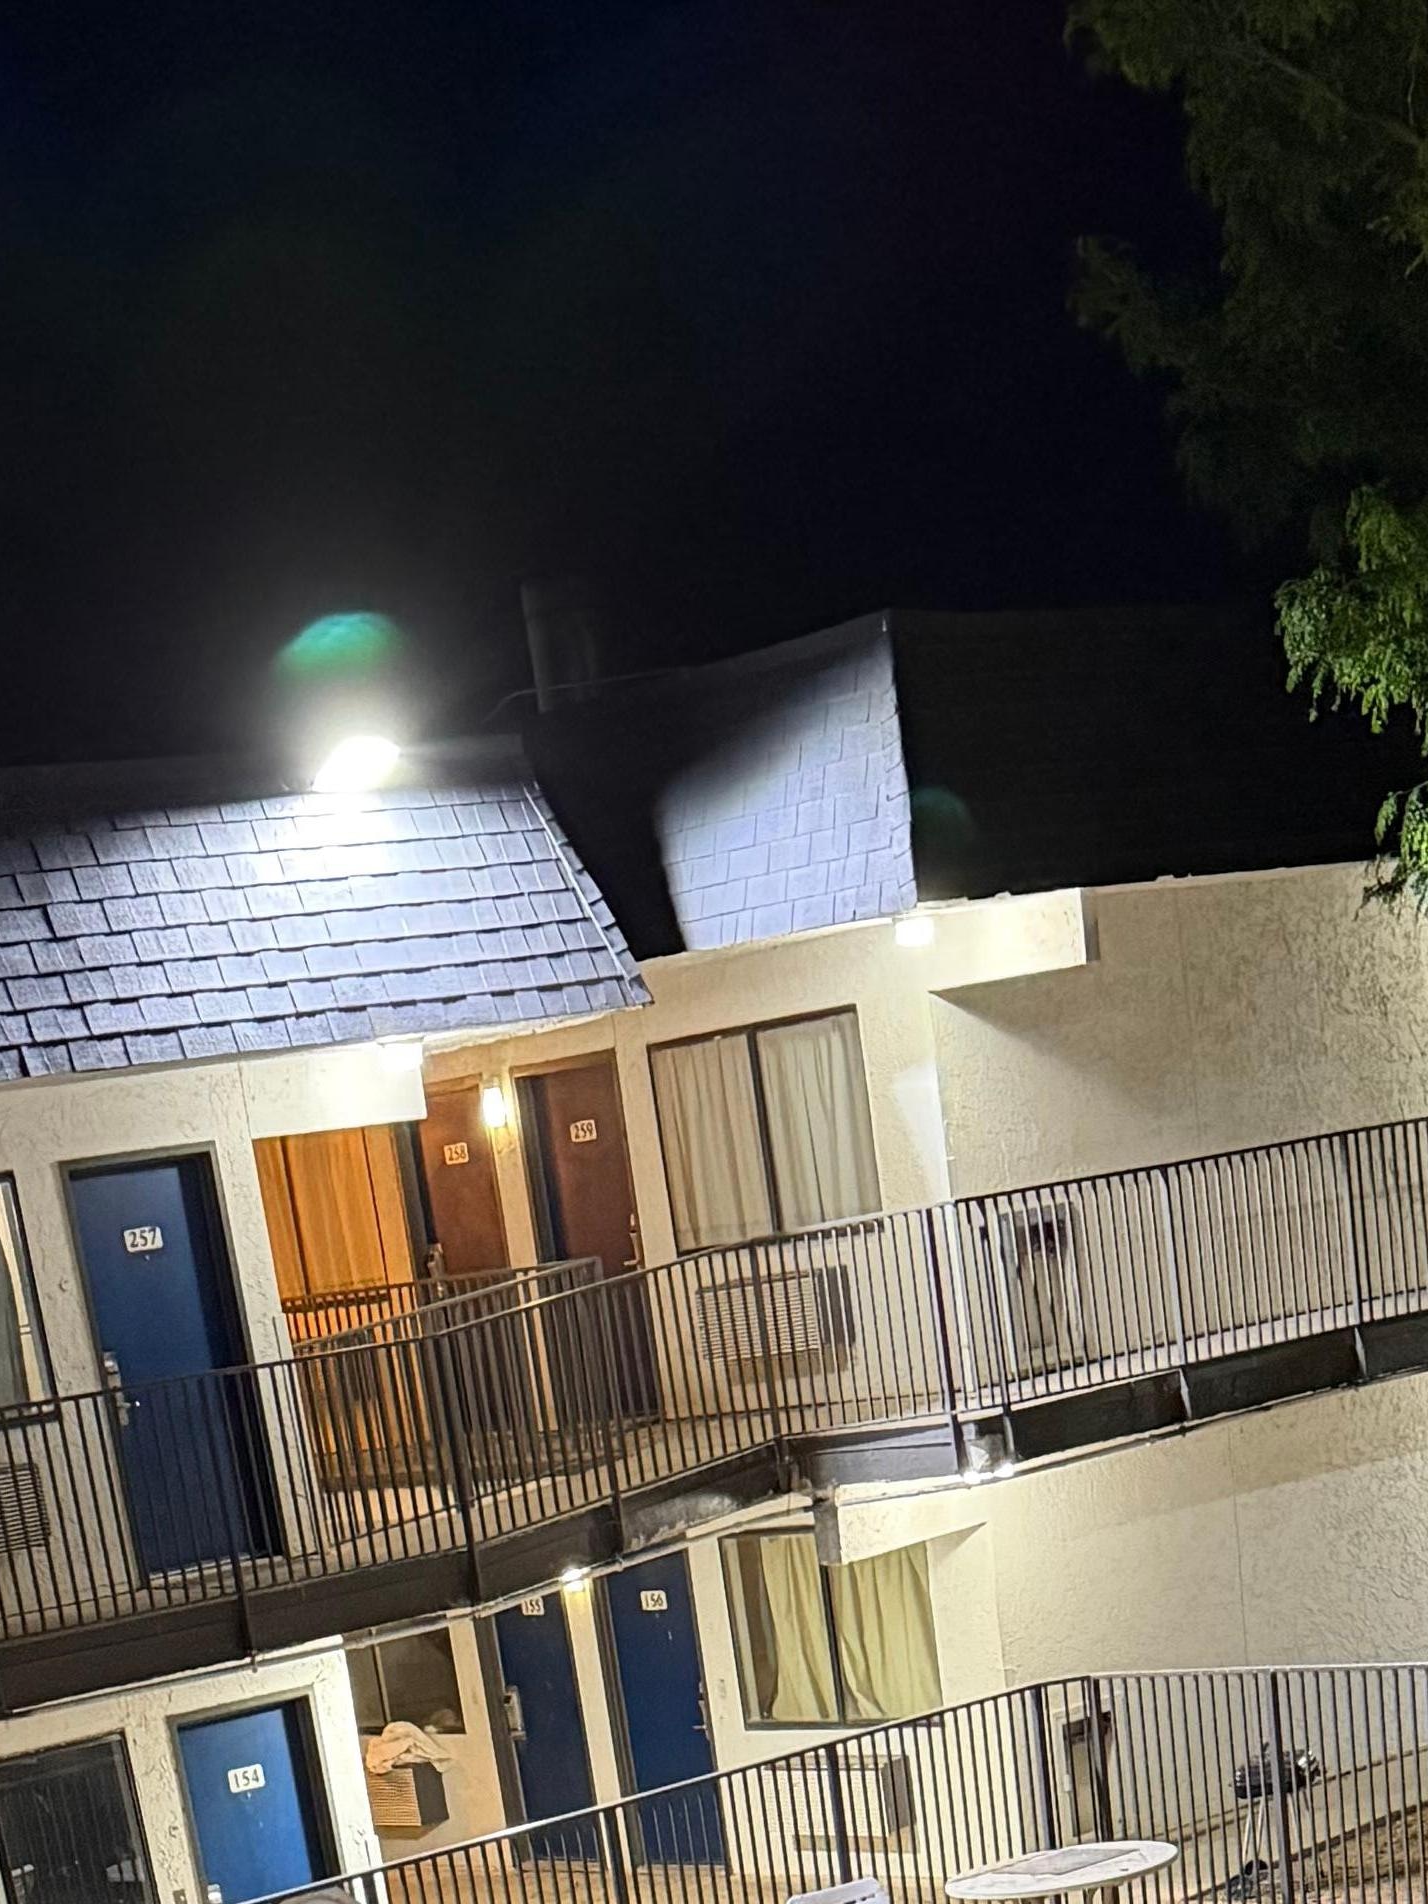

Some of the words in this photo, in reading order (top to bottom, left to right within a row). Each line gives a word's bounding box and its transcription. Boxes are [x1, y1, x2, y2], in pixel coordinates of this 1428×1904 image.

[574, 1122, 593, 1139] 259
[129, 1227, 157, 1248] 257
[524, 1599, 541, 1613] 155
[645, 1593, 663, 1608] 156
[234, 1768, 260, 1788] 154
